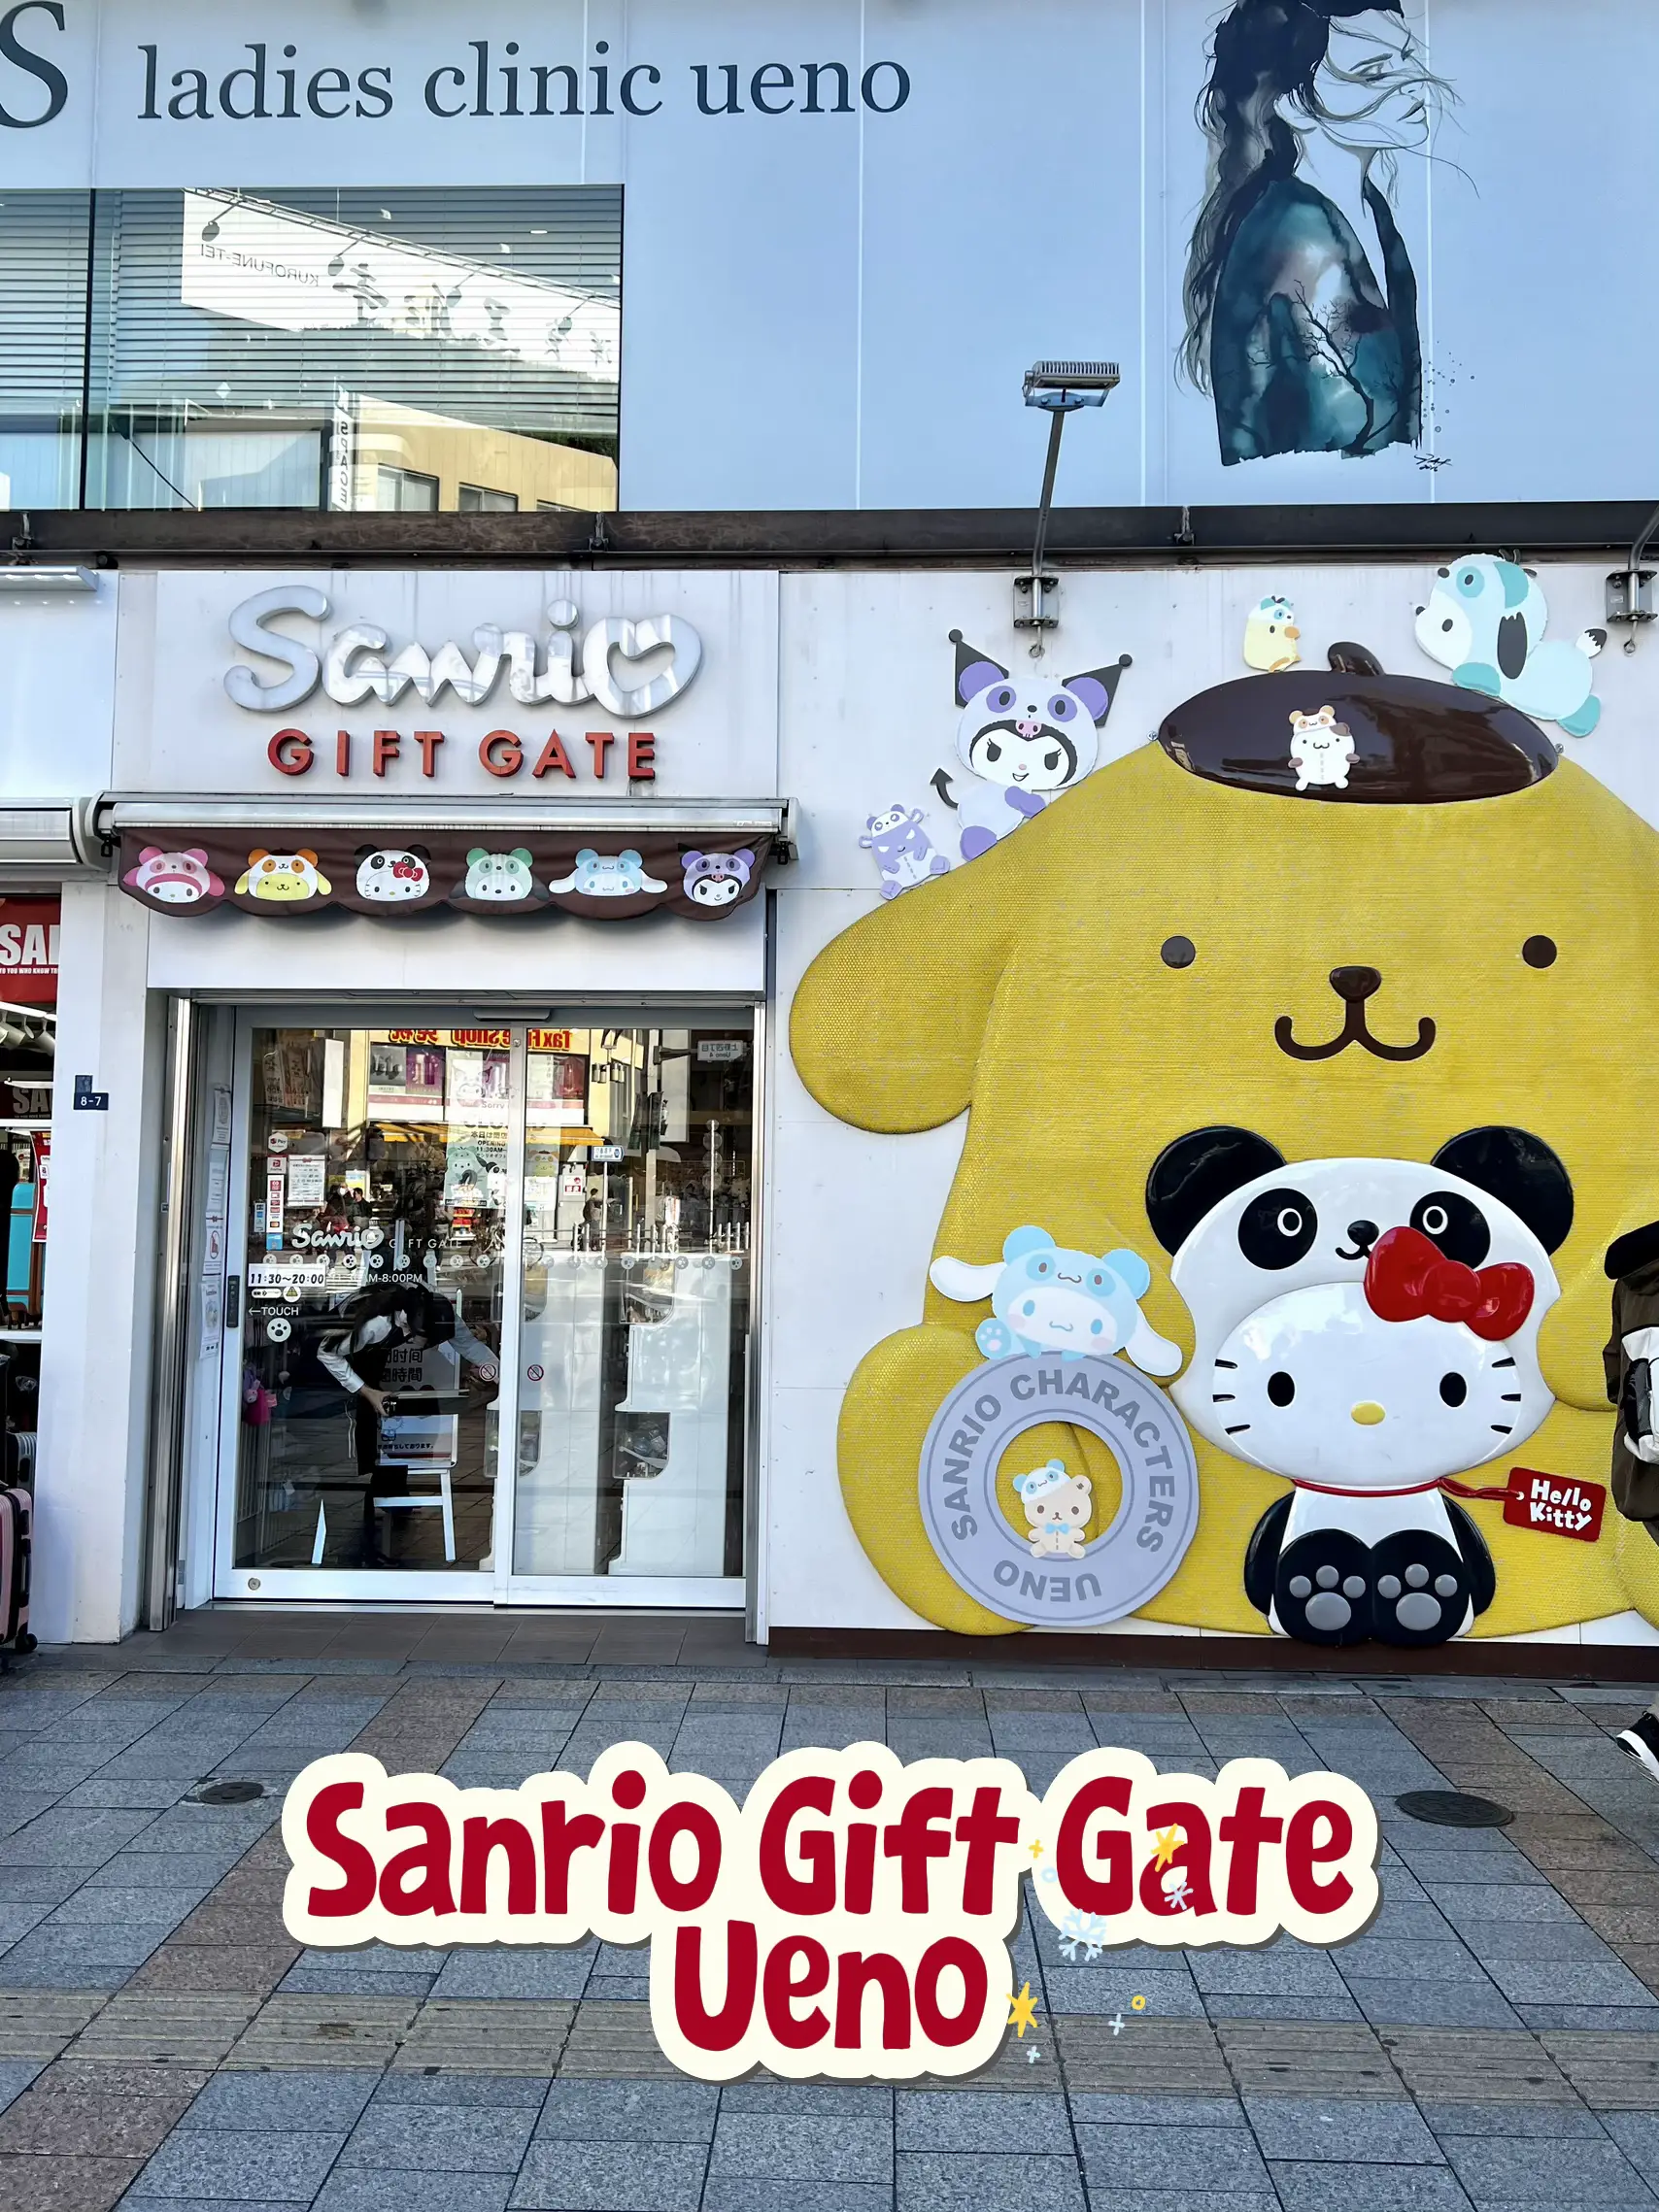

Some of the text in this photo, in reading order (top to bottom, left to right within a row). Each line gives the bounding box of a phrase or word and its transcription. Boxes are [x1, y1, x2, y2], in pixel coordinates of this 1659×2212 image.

[137, 43, 393, 120] ladies
[423, 40, 663, 117] clinic
[690, 61, 911, 116] ueno
[223, 585, 702, 719] Sanrio
[267, 728, 656, 779] GIFT GATE
[13, 1088, 51, 1114] SA
[81, 1096, 102, 1106] 8-7
[291, 1223, 384, 1249] Sanrio
[389, 1238, 462, 1249] GFT GATE
[365, 1273, 423, 1283] M-8:00PM
[261, 1306, 299, 1317] TOUCH
[942, 1369, 1175, 1553] SANRIO CHARACTERS
[1530, 1478, 1592, 1512] Hello
[1530, 1501, 1593, 1531] Kitty
[993, 1559, 1102, 1602] UENO
